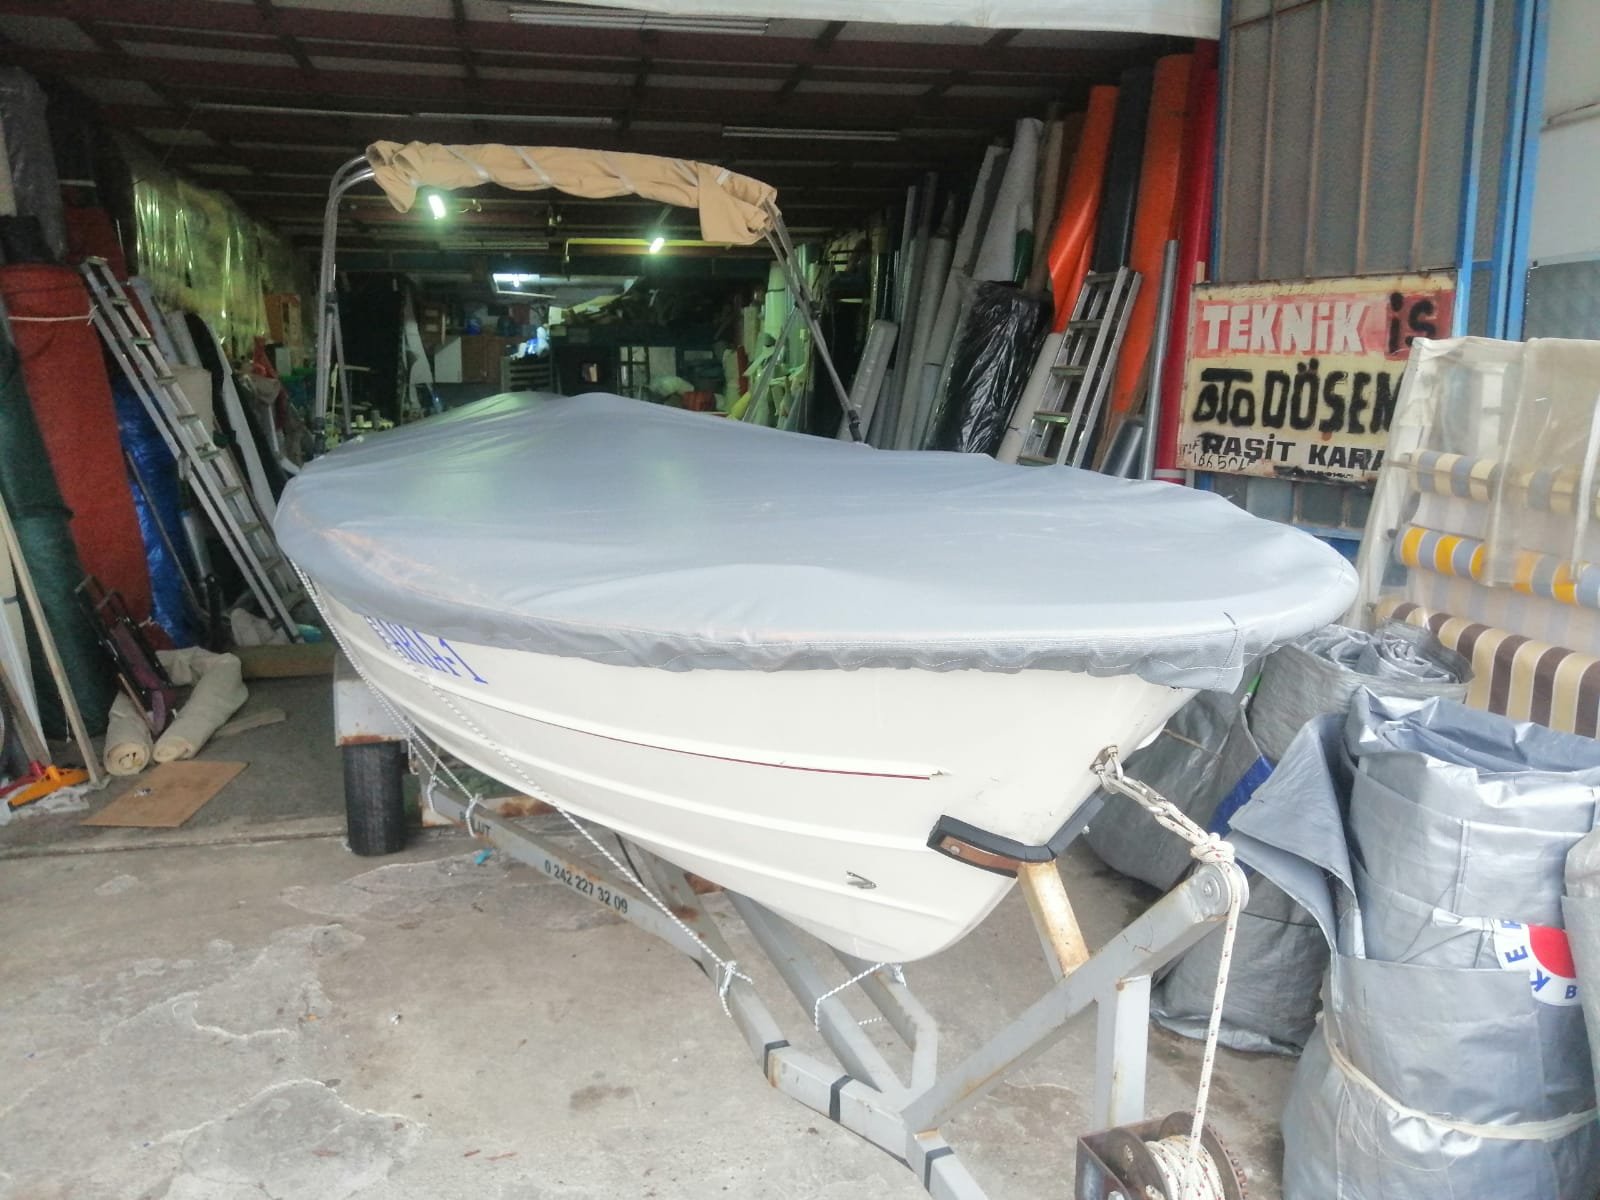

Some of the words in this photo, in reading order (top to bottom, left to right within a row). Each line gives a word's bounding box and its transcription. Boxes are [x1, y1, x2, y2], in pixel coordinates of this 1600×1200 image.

[1192, 367, 1256, 427] OTO
[1199, 432, 1297, 464] RAŞİT
[553, 864, 573, 886] 242
[575, 875, 594, 897] 227
[597, 886, 612, 906] 32
[614, 895, 629, 914] 09
